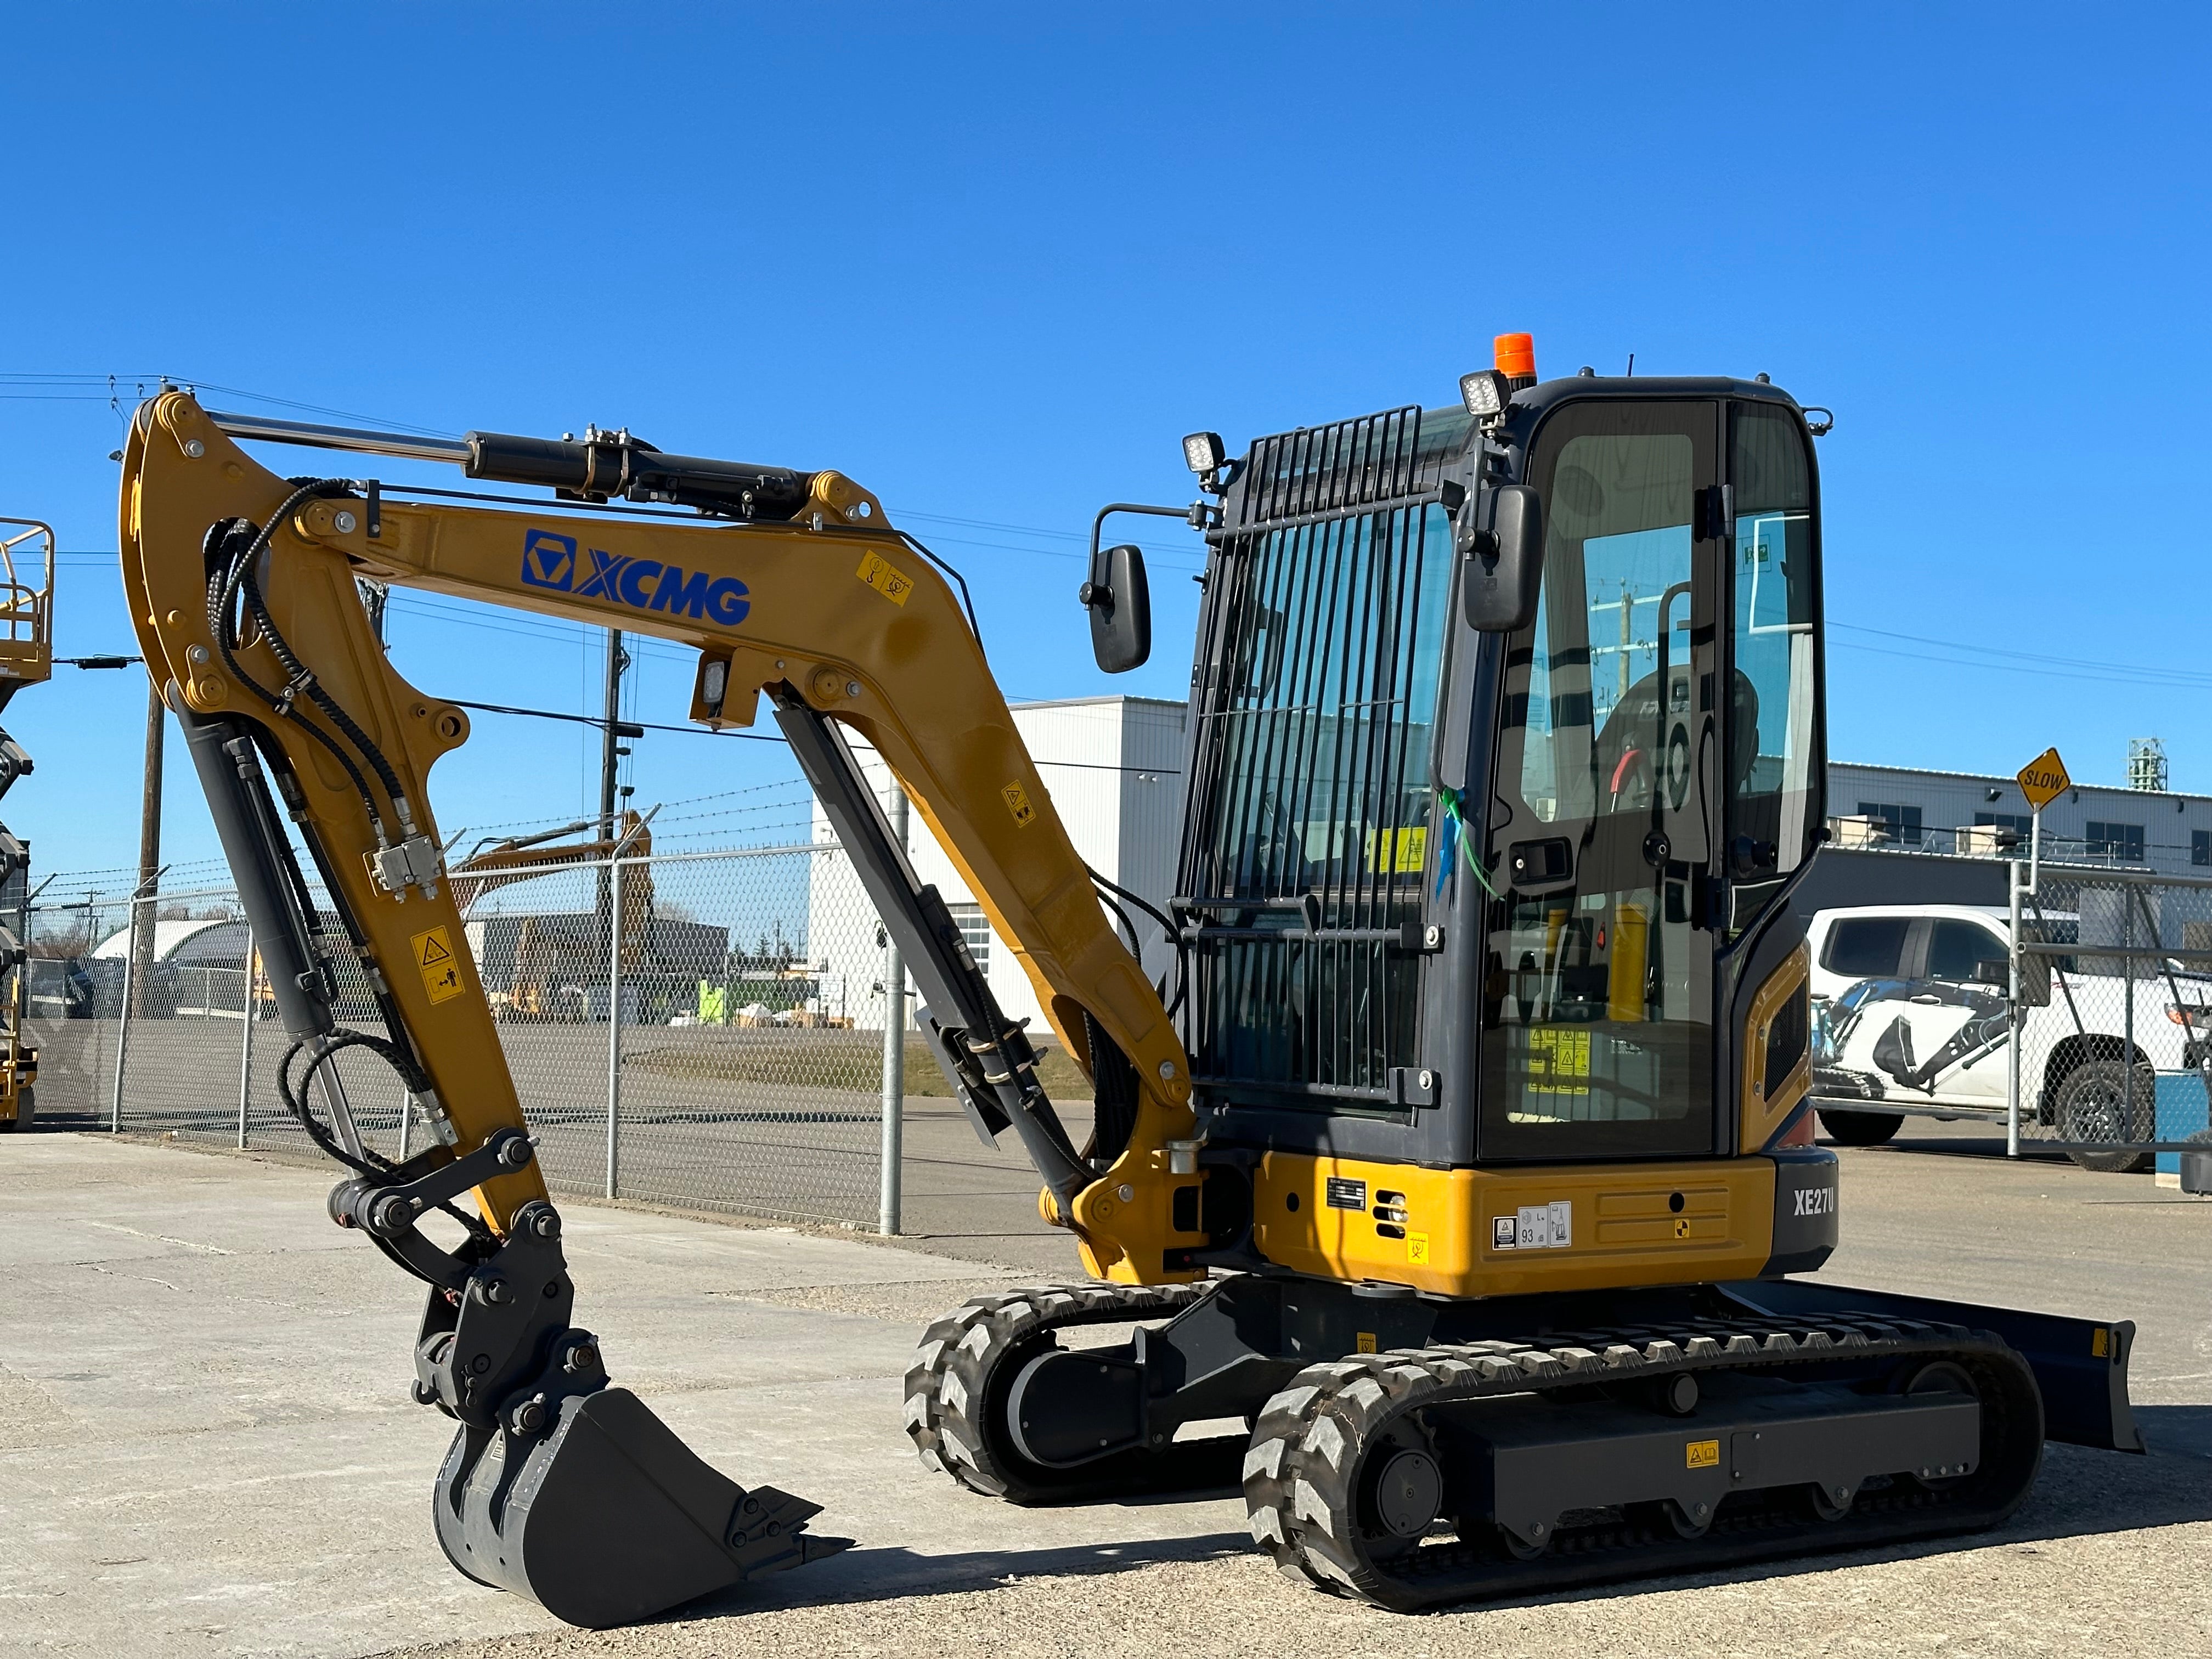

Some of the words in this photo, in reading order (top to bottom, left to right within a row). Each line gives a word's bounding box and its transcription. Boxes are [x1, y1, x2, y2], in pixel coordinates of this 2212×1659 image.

[572, 548, 751, 626] XCMG
[2024, 769, 2065, 790] SLOW
[1794, 1186, 1833, 1216] XE27U
[1522, 1228, 1533, 1243] 93
